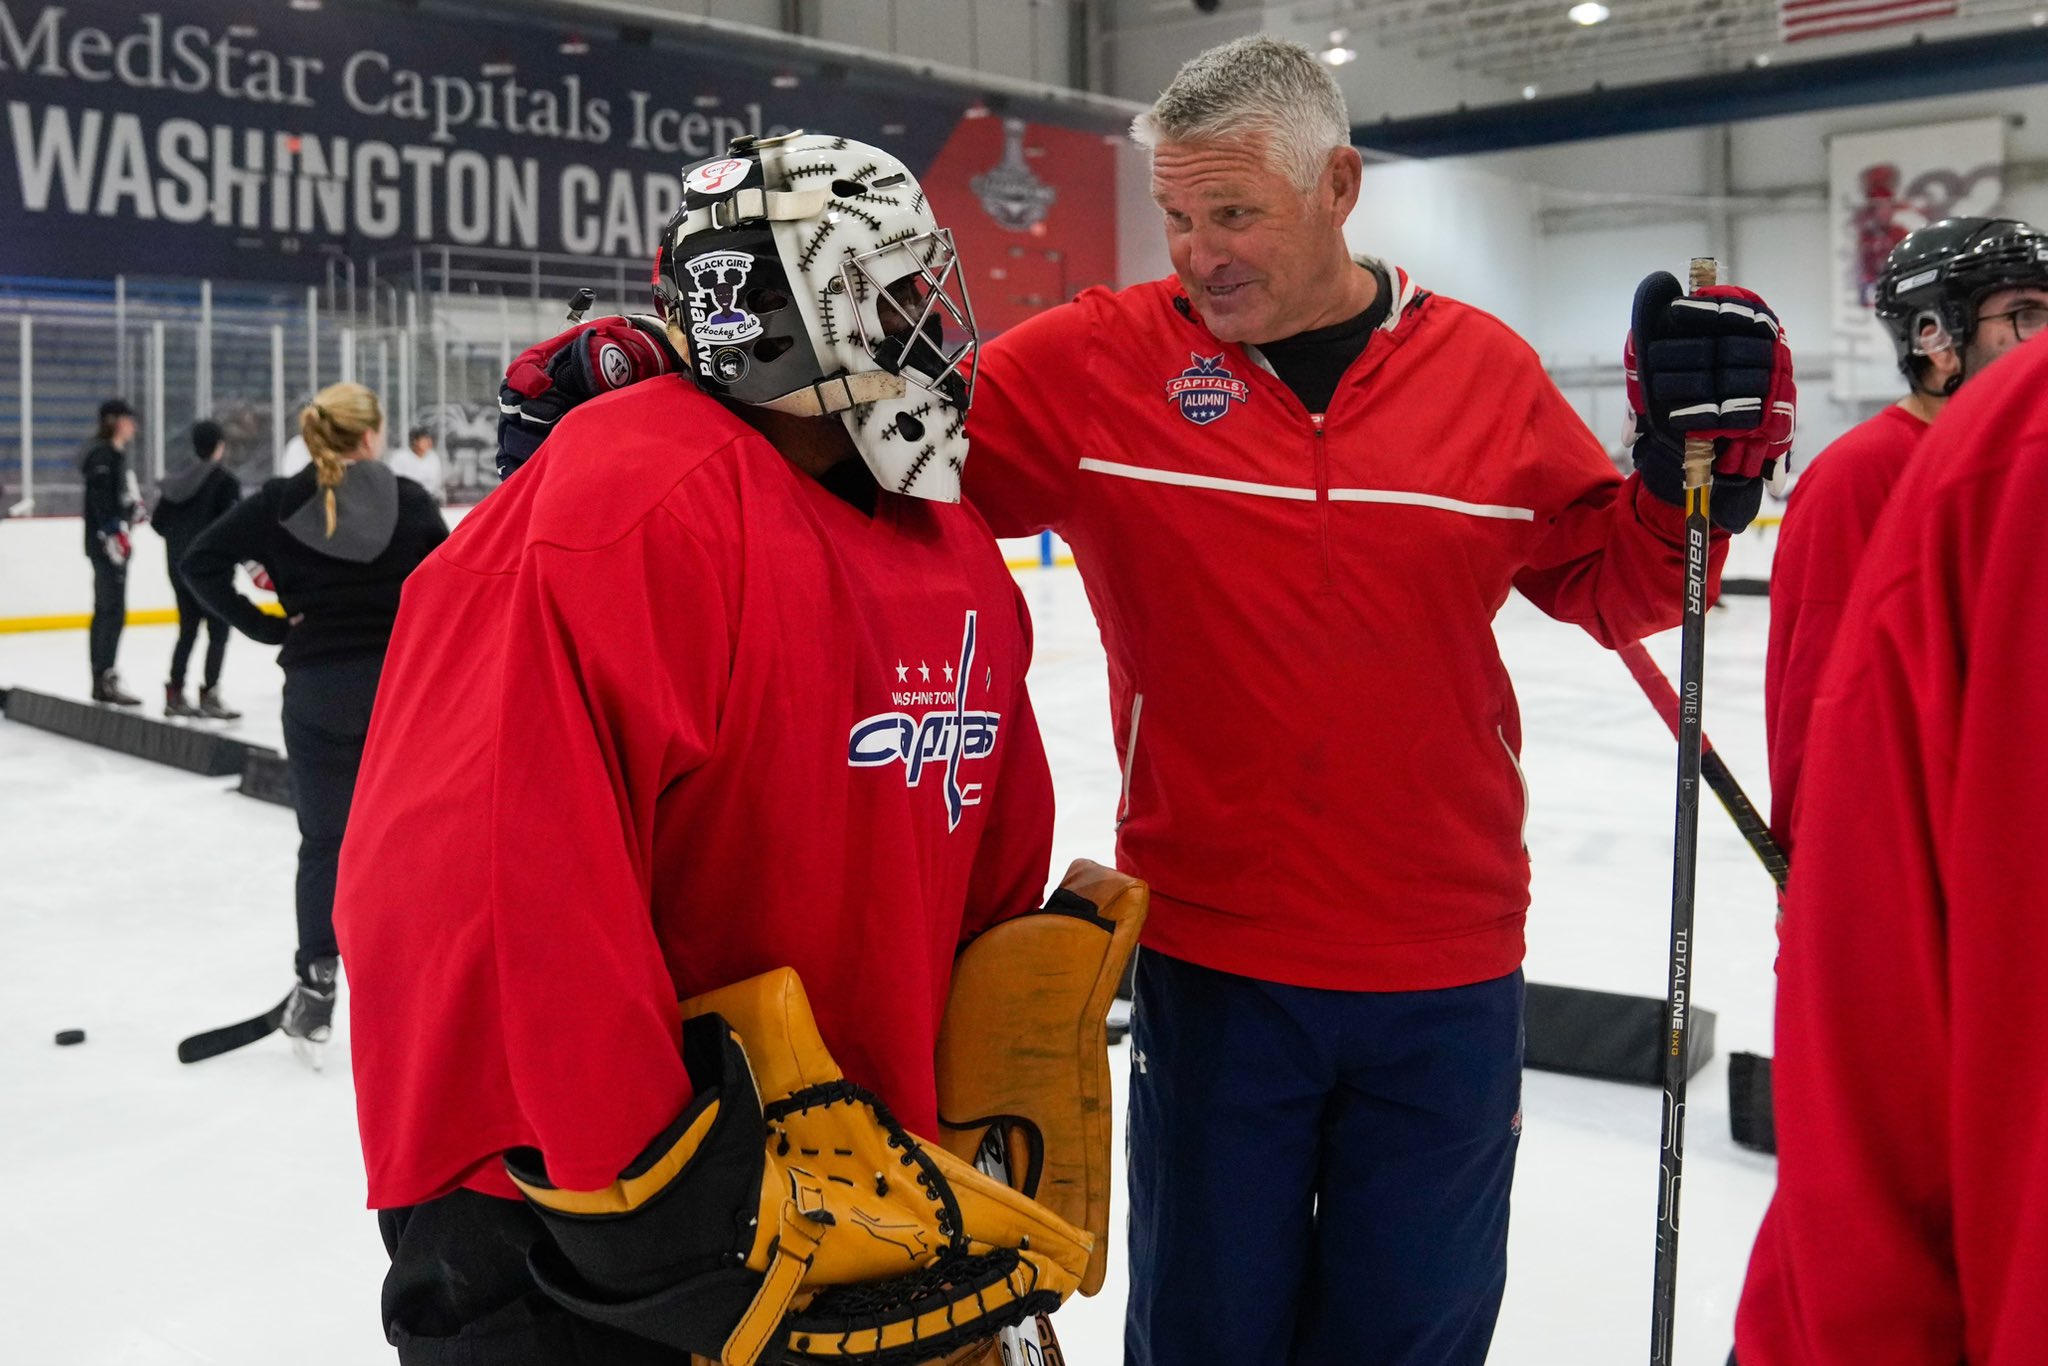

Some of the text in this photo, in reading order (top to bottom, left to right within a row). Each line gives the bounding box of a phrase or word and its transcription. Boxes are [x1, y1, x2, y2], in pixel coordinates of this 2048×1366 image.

[0, 2, 323, 105] MedStar
[342, 51, 612, 143] Capitals
[11, 101, 539, 249] WASHINGTON
[691, 258, 748, 274] BLACK GIRL
[694, 317, 757, 340] Hockey Club
[1173, 379, 1239, 390] CAPITALS
[1185, 394, 1224, 406] ALUMNI
[1684, 681, 1698, 724] OVIE 8
